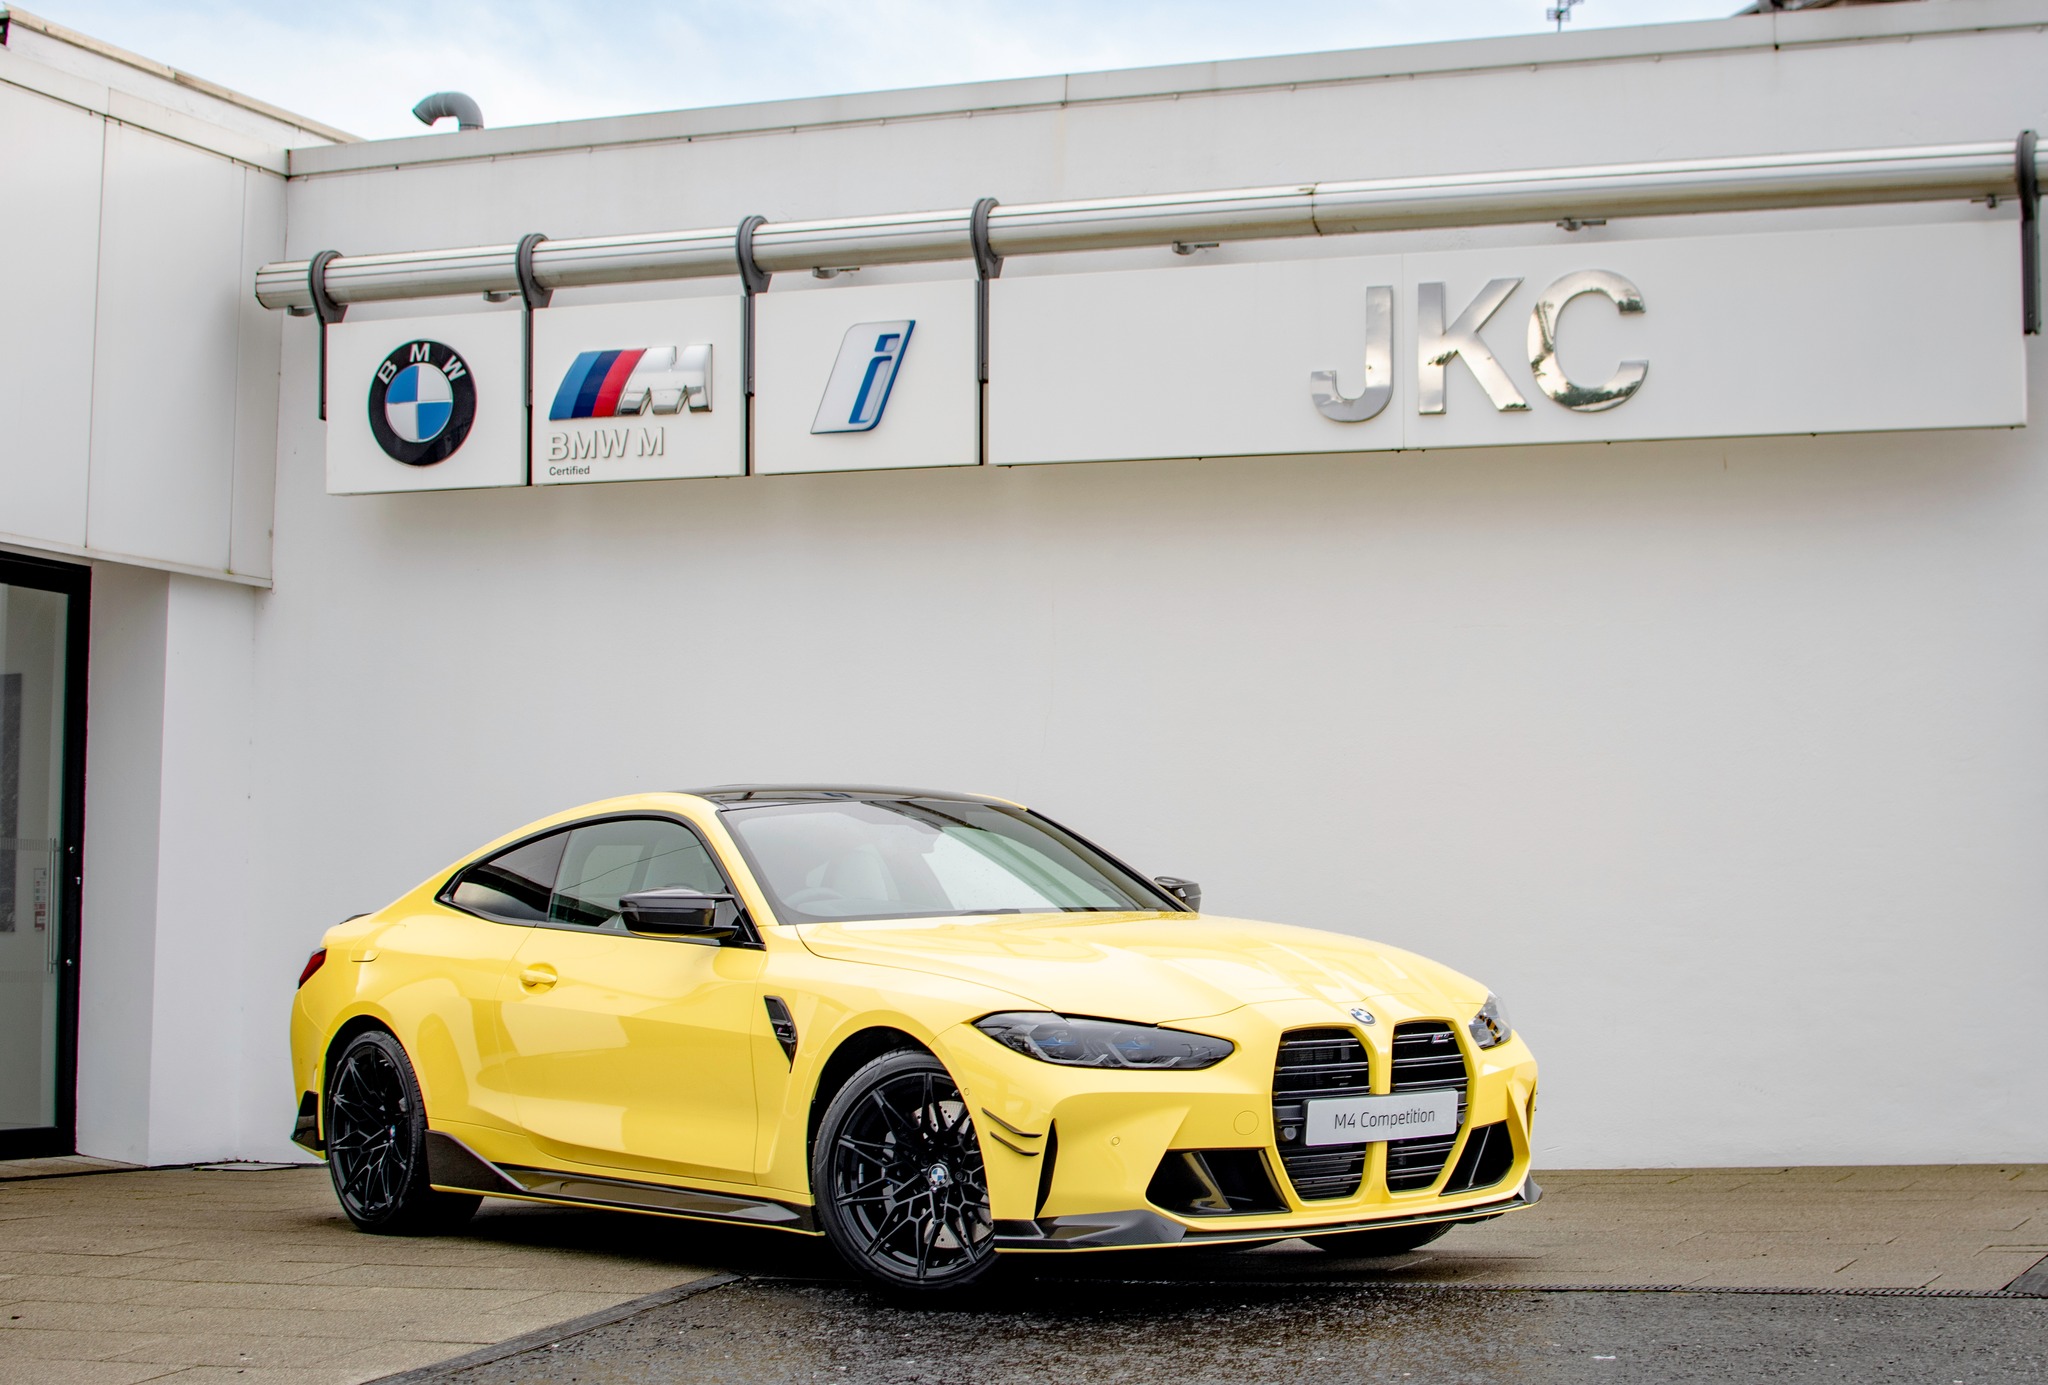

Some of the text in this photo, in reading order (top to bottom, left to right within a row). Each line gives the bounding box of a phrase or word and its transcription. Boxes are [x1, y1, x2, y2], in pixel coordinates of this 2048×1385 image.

[377, 342, 467, 385] BMW
[1310, 269, 1649, 423] JKC
[548, 426, 664, 462] BMW M
[549, 465, 591, 476] Certified
[1334, 1108, 1435, 1129] M4 Competition
